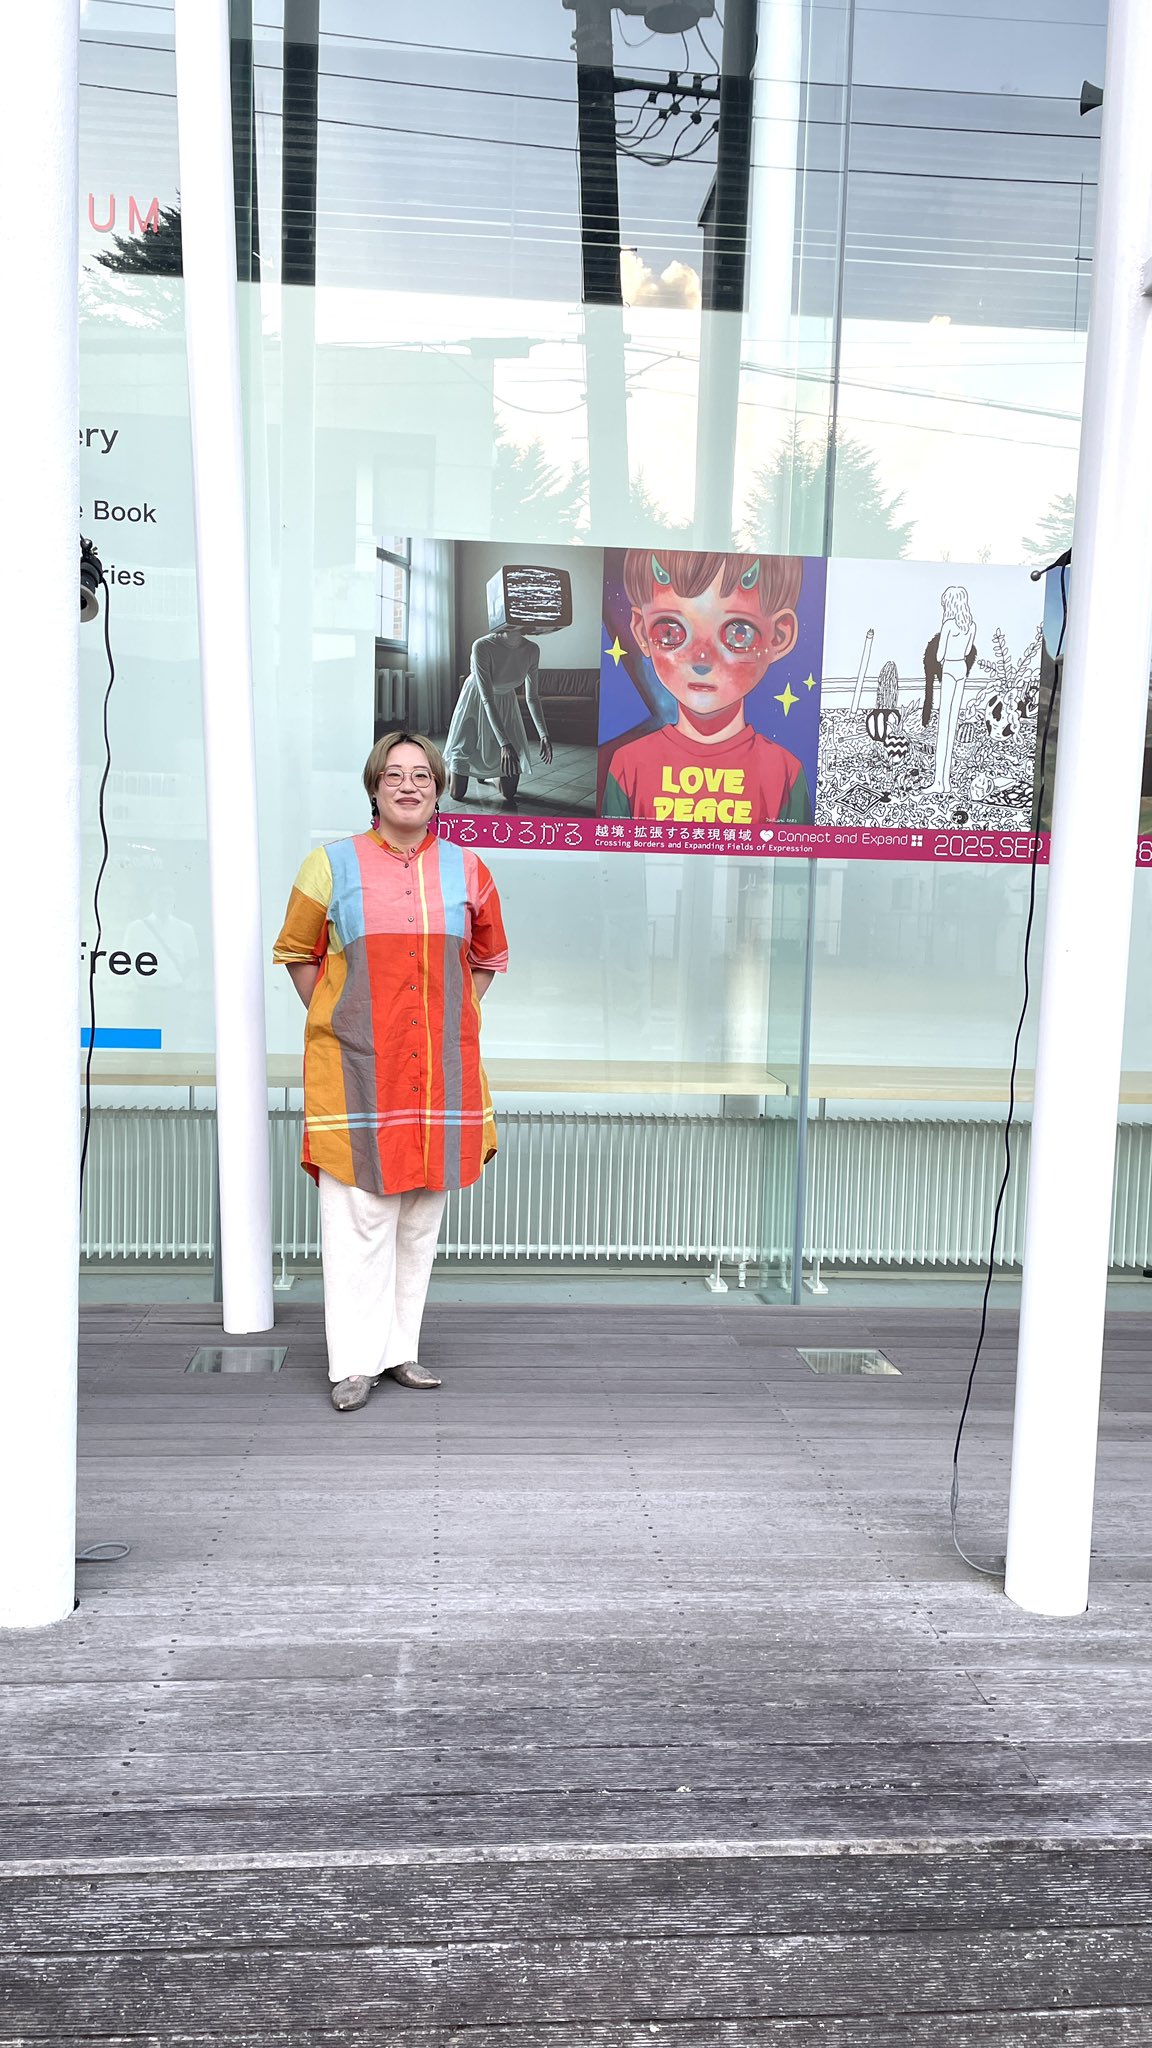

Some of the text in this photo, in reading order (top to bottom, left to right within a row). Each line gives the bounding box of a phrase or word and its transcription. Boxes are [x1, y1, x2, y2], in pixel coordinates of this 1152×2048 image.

[89, 192, 159, 234] UM
[79, 428, 119, 454] ry
[94, 500, 157, 523] Book
[662, 766, 745, 794] LOVE
[653, 797, 752, 824] PEACE
[427, 819, 583, 846] がる・ひろがる
[595, 839, 631, 848] Crossing
[634, 840, 665, 848] Borders
[684, 842, 724, 851] Expanding
[727, 843, 754, 851] Fields
[769, 844, 813, 852] Expression
[777, 830, 909, 846] Connect and Expand
[934, 835, 1051, 859] 2025.SEP.
[81, 941, 158, 976] ree
